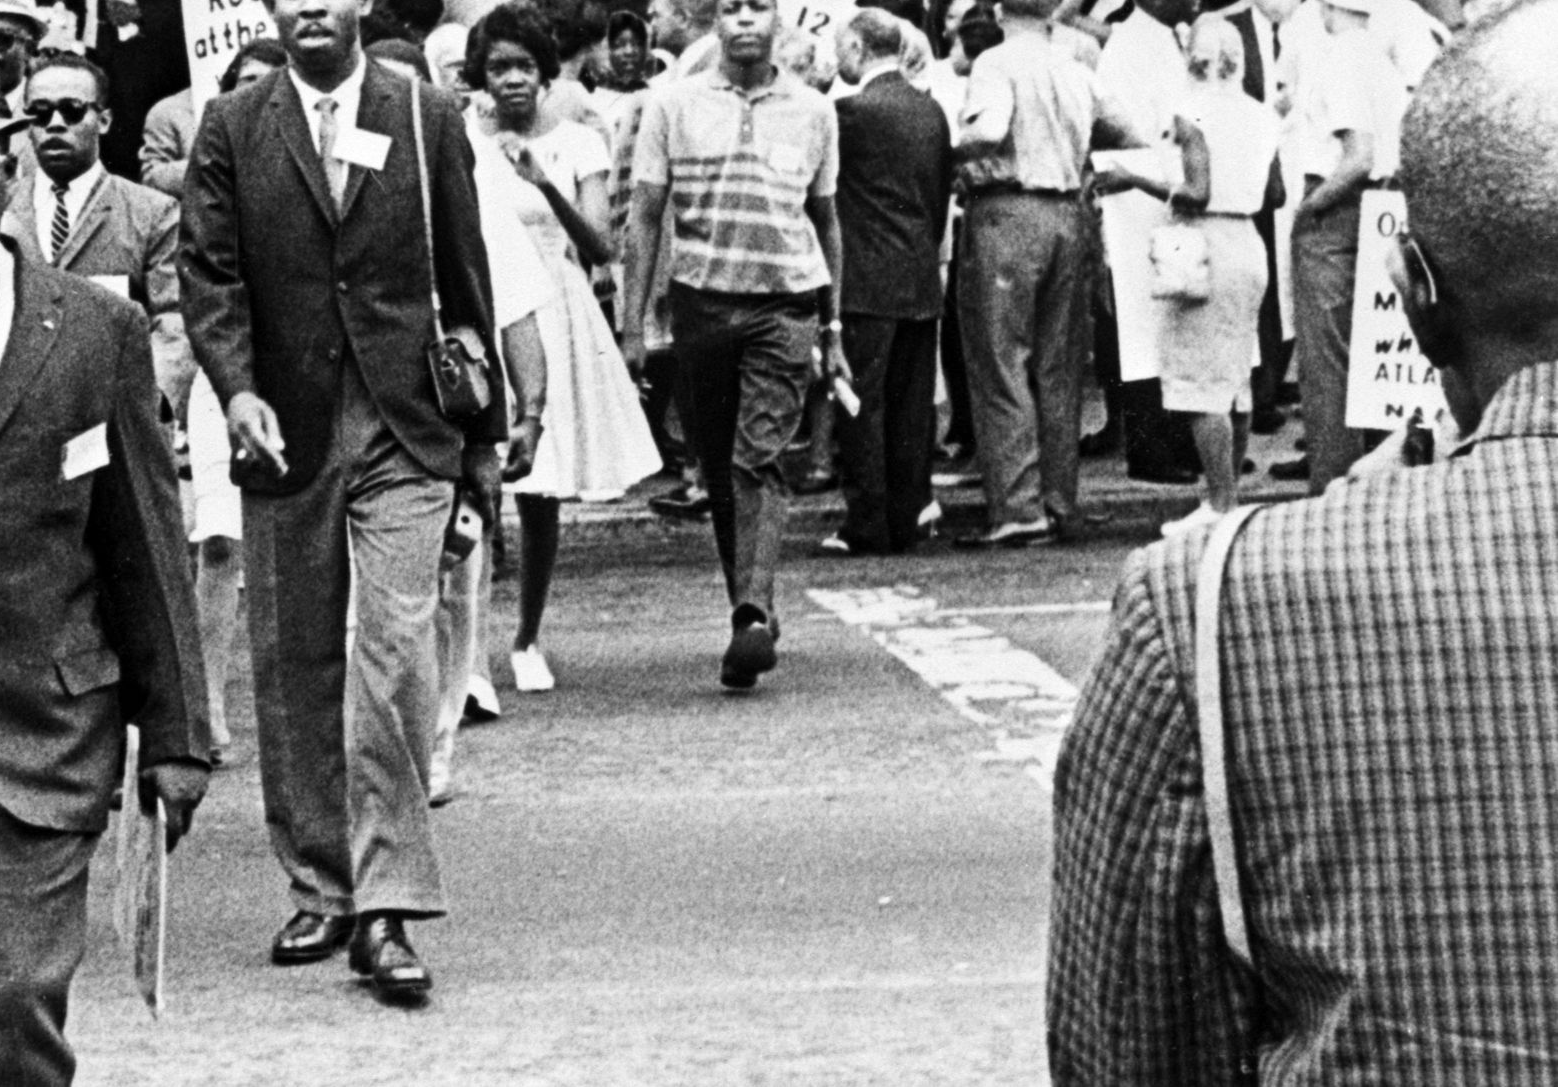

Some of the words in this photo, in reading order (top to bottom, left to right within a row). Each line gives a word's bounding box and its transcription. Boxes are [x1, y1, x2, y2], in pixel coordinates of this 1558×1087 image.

[1374, 291, 1396, 310] M
[1375, 331, 1412, 354] wh
[1374, 362, 1436, 384] ATLA
